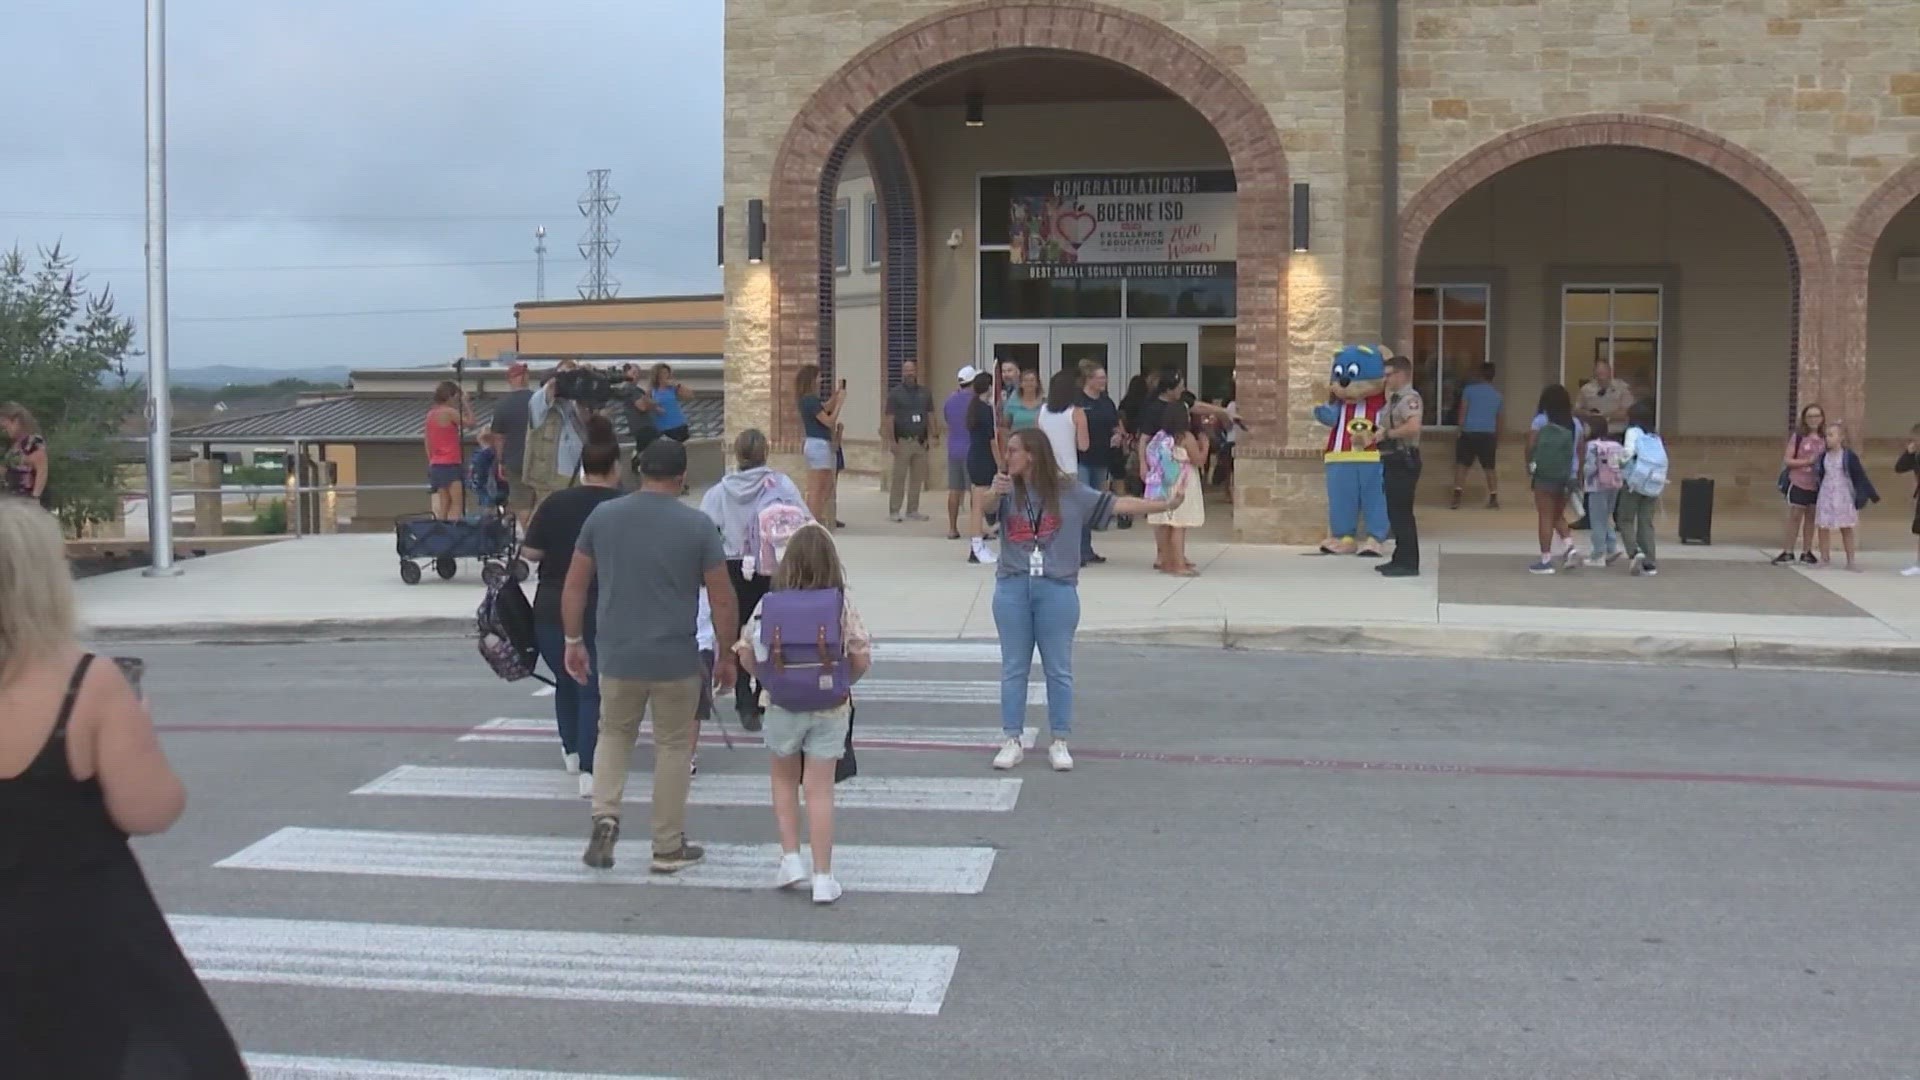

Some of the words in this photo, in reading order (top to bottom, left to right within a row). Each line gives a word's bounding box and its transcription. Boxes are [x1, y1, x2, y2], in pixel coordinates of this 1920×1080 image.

[1053, 176, 1198, 196] CONGRATULATIONS!
[1097, 203, 1154, 222] BOERNE
[1159, 201, 1184, 221] ISD
[1107, 238, 1164, 246] EDUCATION
[1171, 224, 1201, 243] 2020
[1029, 267, 1051, 278] BEST
[1054, 266, 1084, 278] SMALL
[1088, 266, 1123, 277] SCHOOL
[1126, 265, 1168, 276] DISTRICT
[1172, 265, 1182, 276] IN
[1185, 265, 1217, 276] TEXAS!
